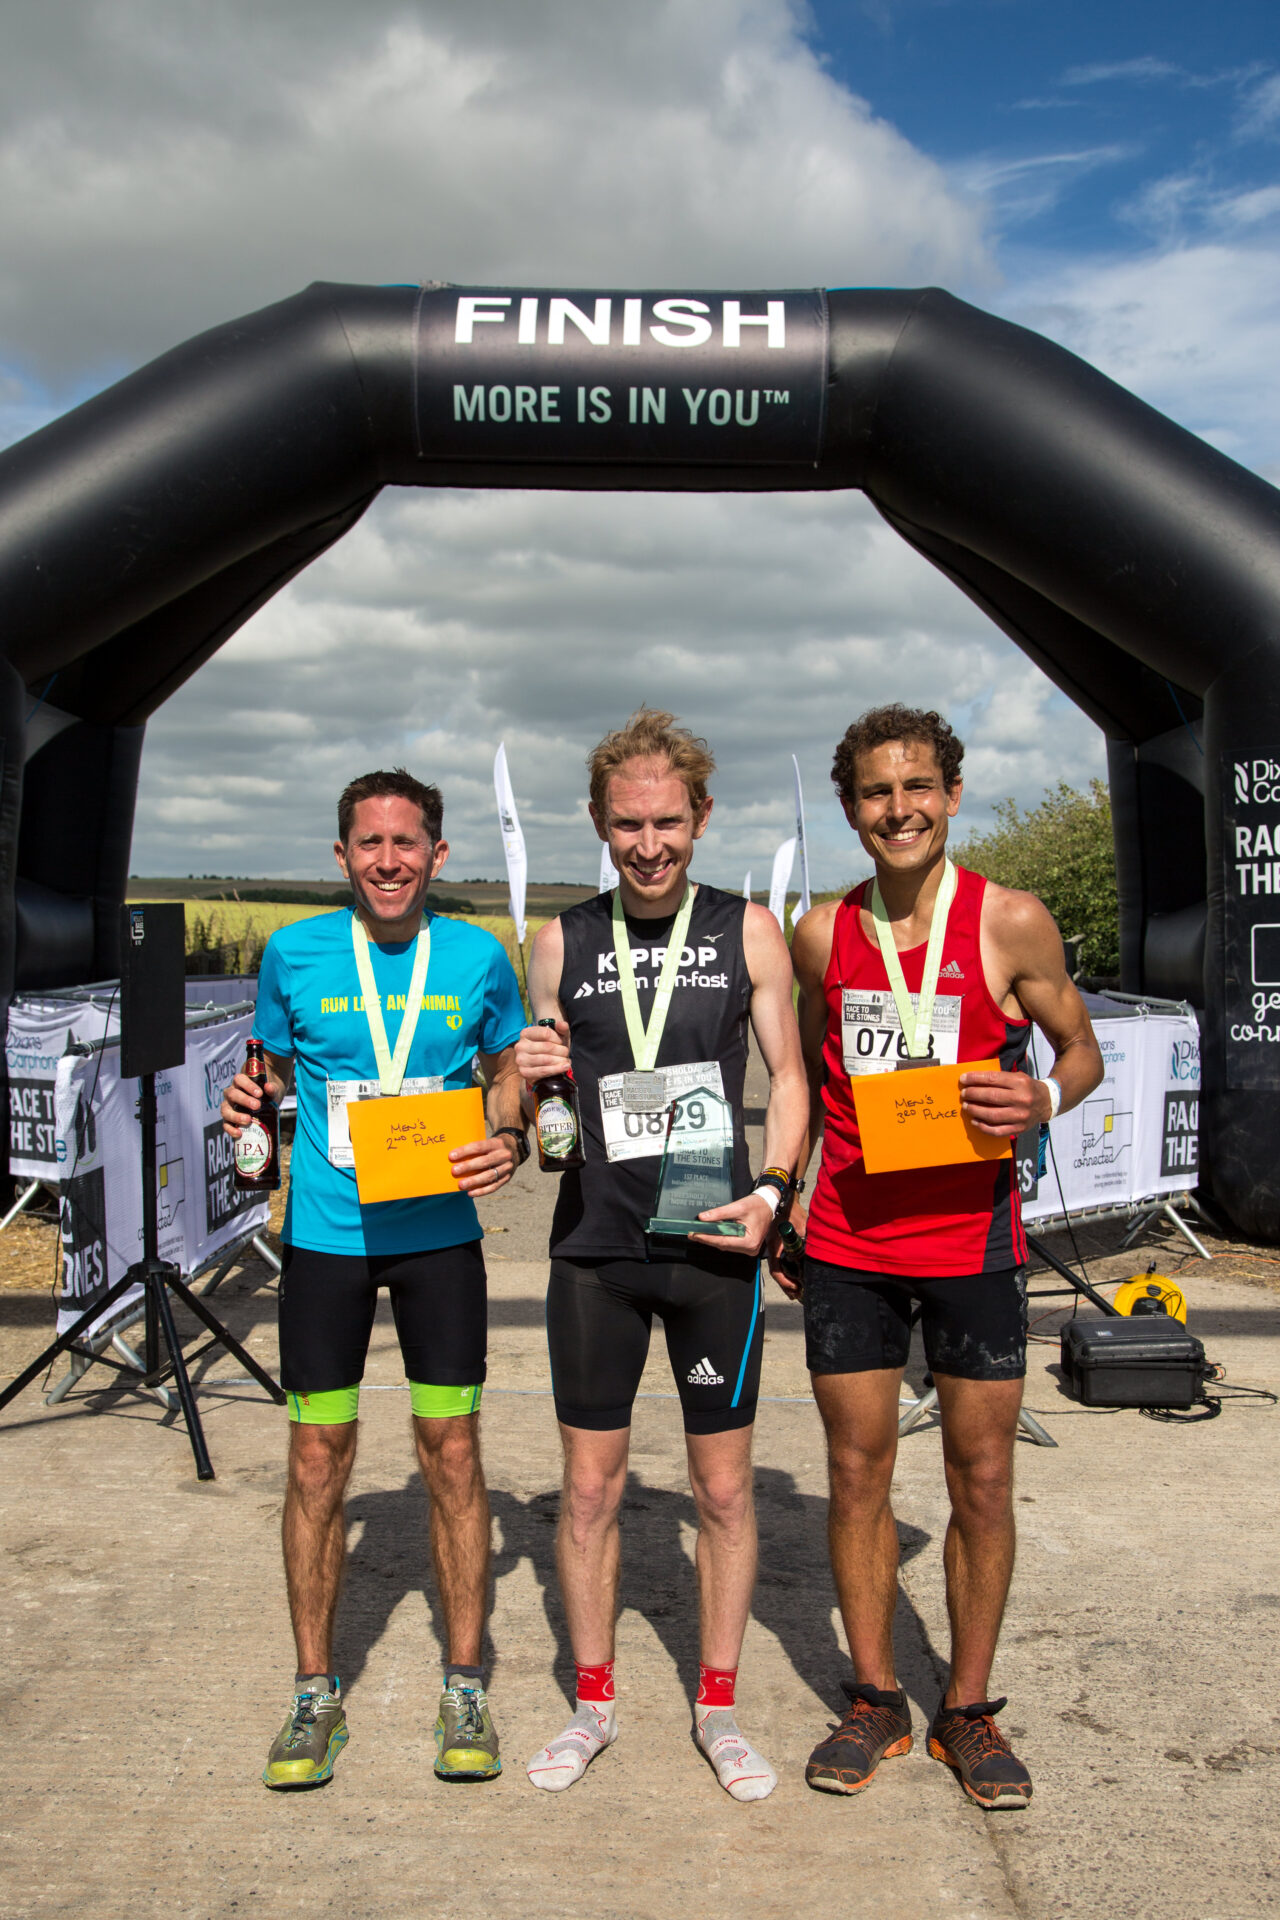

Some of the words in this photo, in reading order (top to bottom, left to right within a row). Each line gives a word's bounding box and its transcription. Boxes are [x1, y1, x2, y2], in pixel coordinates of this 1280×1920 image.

[455, 297, 786, 348] FINISH
[453, 385, 561, 423] MORE
[577, 387, 612, 424] IS
[629, 387, 666, 424] IN
[598, 946, 718, 974] KPROP
[654, 971, 729, 988] rn-fast
[321, 996, 349, 1014] RUN
[386, 994, 406, 1011] AN
[420, 995, 461, 1011] NIMAL
[846, 1005, 860, 1013] RACE
[861, 1006, 870, 1014] TO
[846, 1012, 856, 1021] THE
[857, 1013, 880, 1023] STONES
[10, 1087, 41, 1119] ACE
[923, 1108, 958, 1121] PLACE
[412, 1133, 447, 1147] PLACE
[1082, 1136, 1096, 1157] get
[236, 1143, 265, 1157] IPA
[1074, 1150, 1115, 1168] connected
[1165, 1135, 1199, 1167] THE
[692, 1156, 721, 1166] STONES
[208, 1173, 231, 1220] THE
[687, 1374, 725, 1385] adidas
